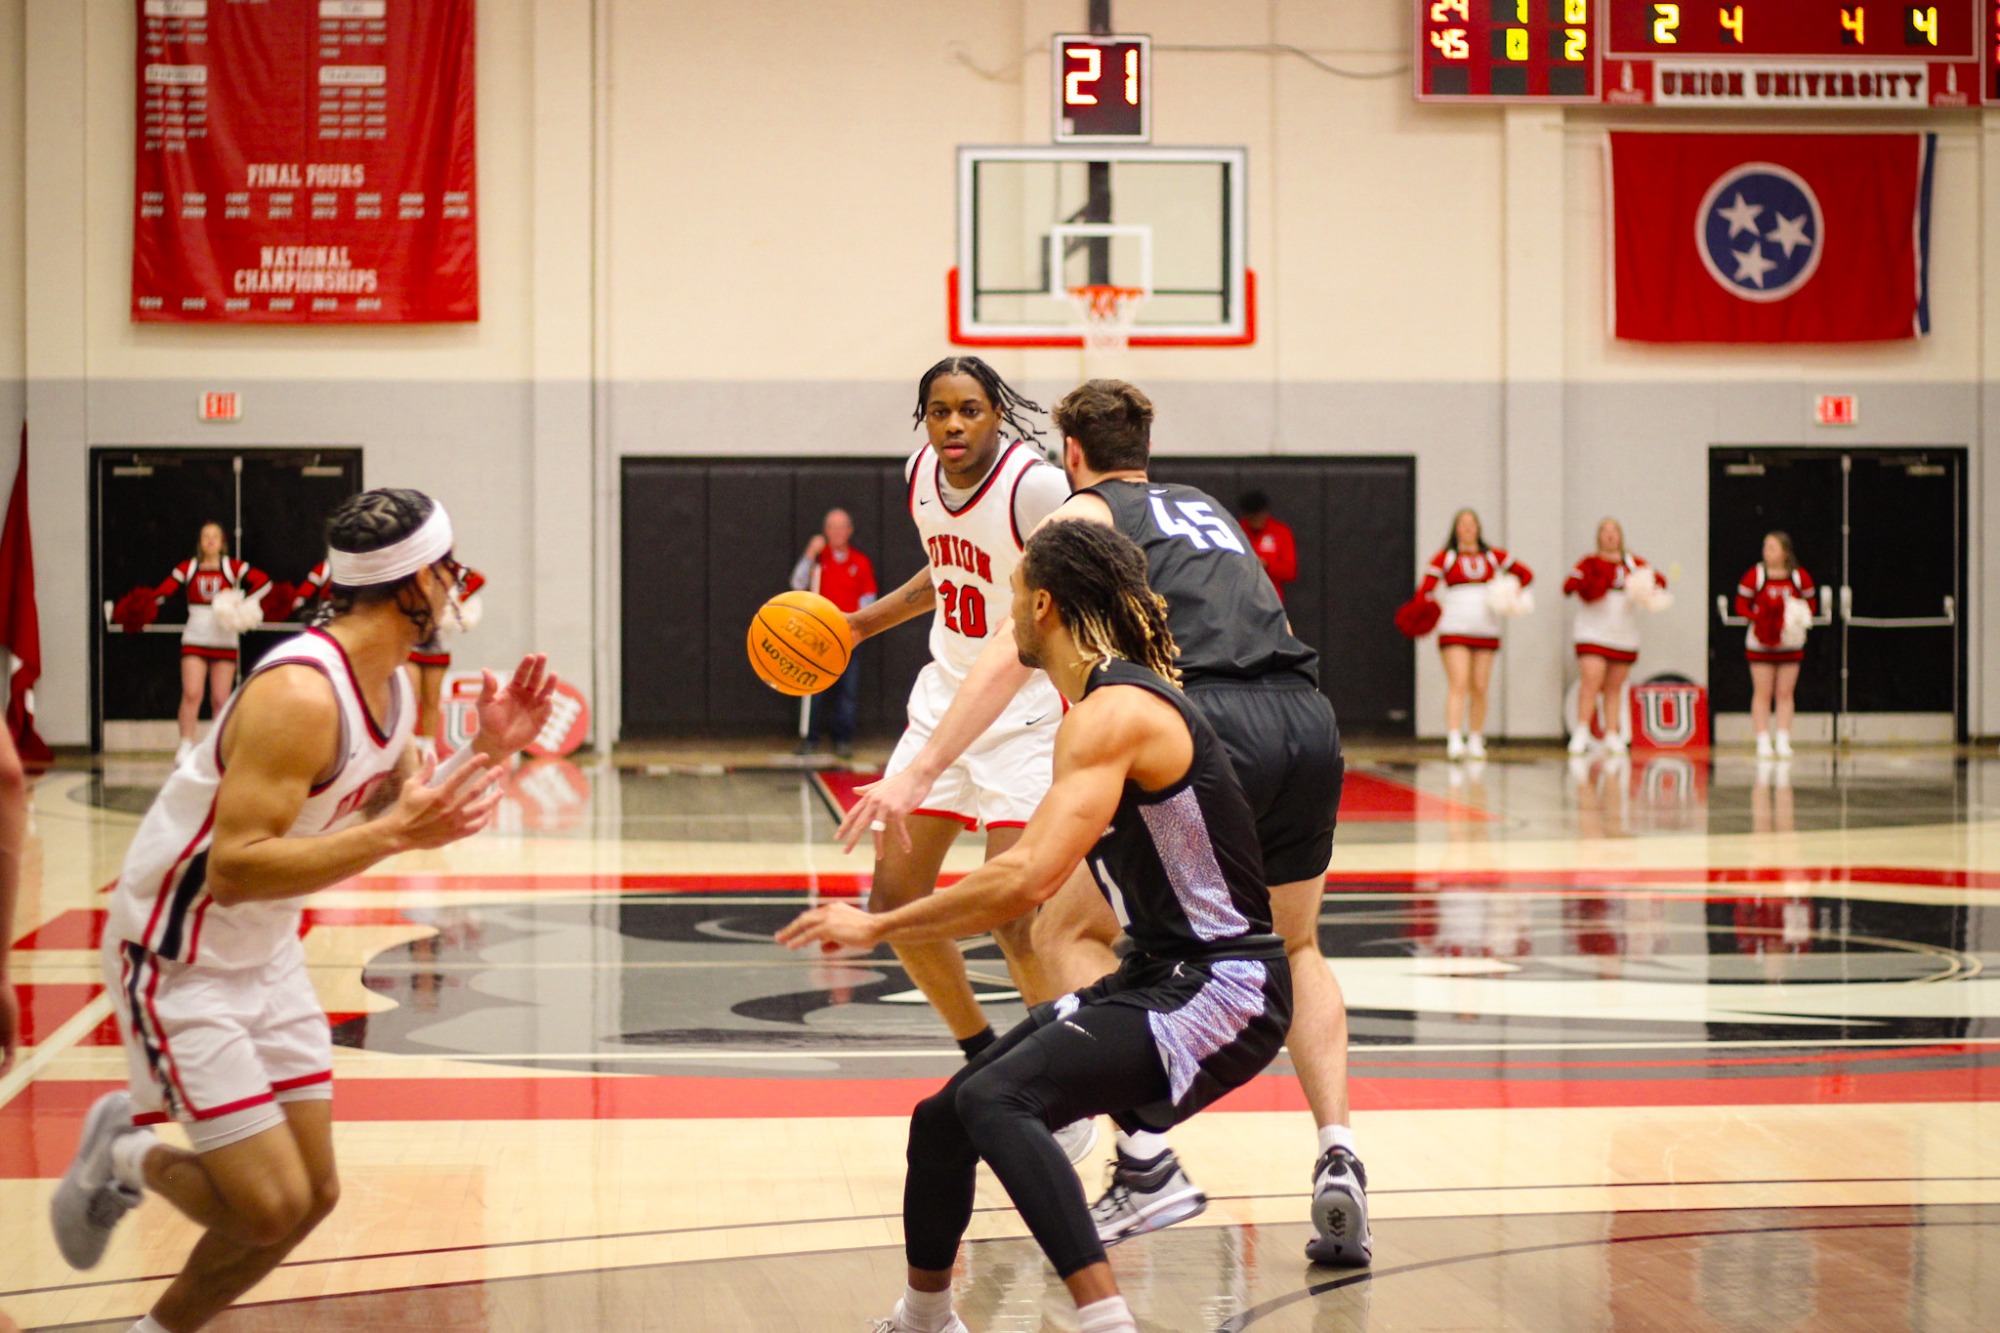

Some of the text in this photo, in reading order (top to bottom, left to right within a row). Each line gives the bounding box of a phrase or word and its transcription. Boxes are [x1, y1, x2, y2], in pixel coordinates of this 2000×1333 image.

[1653, 3, 1680, 44] 2
[1719, 5, 1744, 44] 4
[1840, 6, 1865, 46] 4
[1912, 6, 1938, 47] 4
[1430, 28, 1469, 59] 45
[1564, 28, 1587, 61] 2
[1065, 48, 1138, 105] 21
[1661, 72, 1923, 98] UNION UNIVERSITY
[247, 164, 365, 188] FINAL FOURS
[260, 246, 352, 269] NATIONAL
[233, 269, 378, 294] CHAMPIONSHIPS
[1148, 496, 1246, 555] 45
[927, 533, 994, 585] UNION
[937, 578, 988, 639] 20
[761, 637, 819, 688] Wilson
[1637, 686, 1700, 748] U
